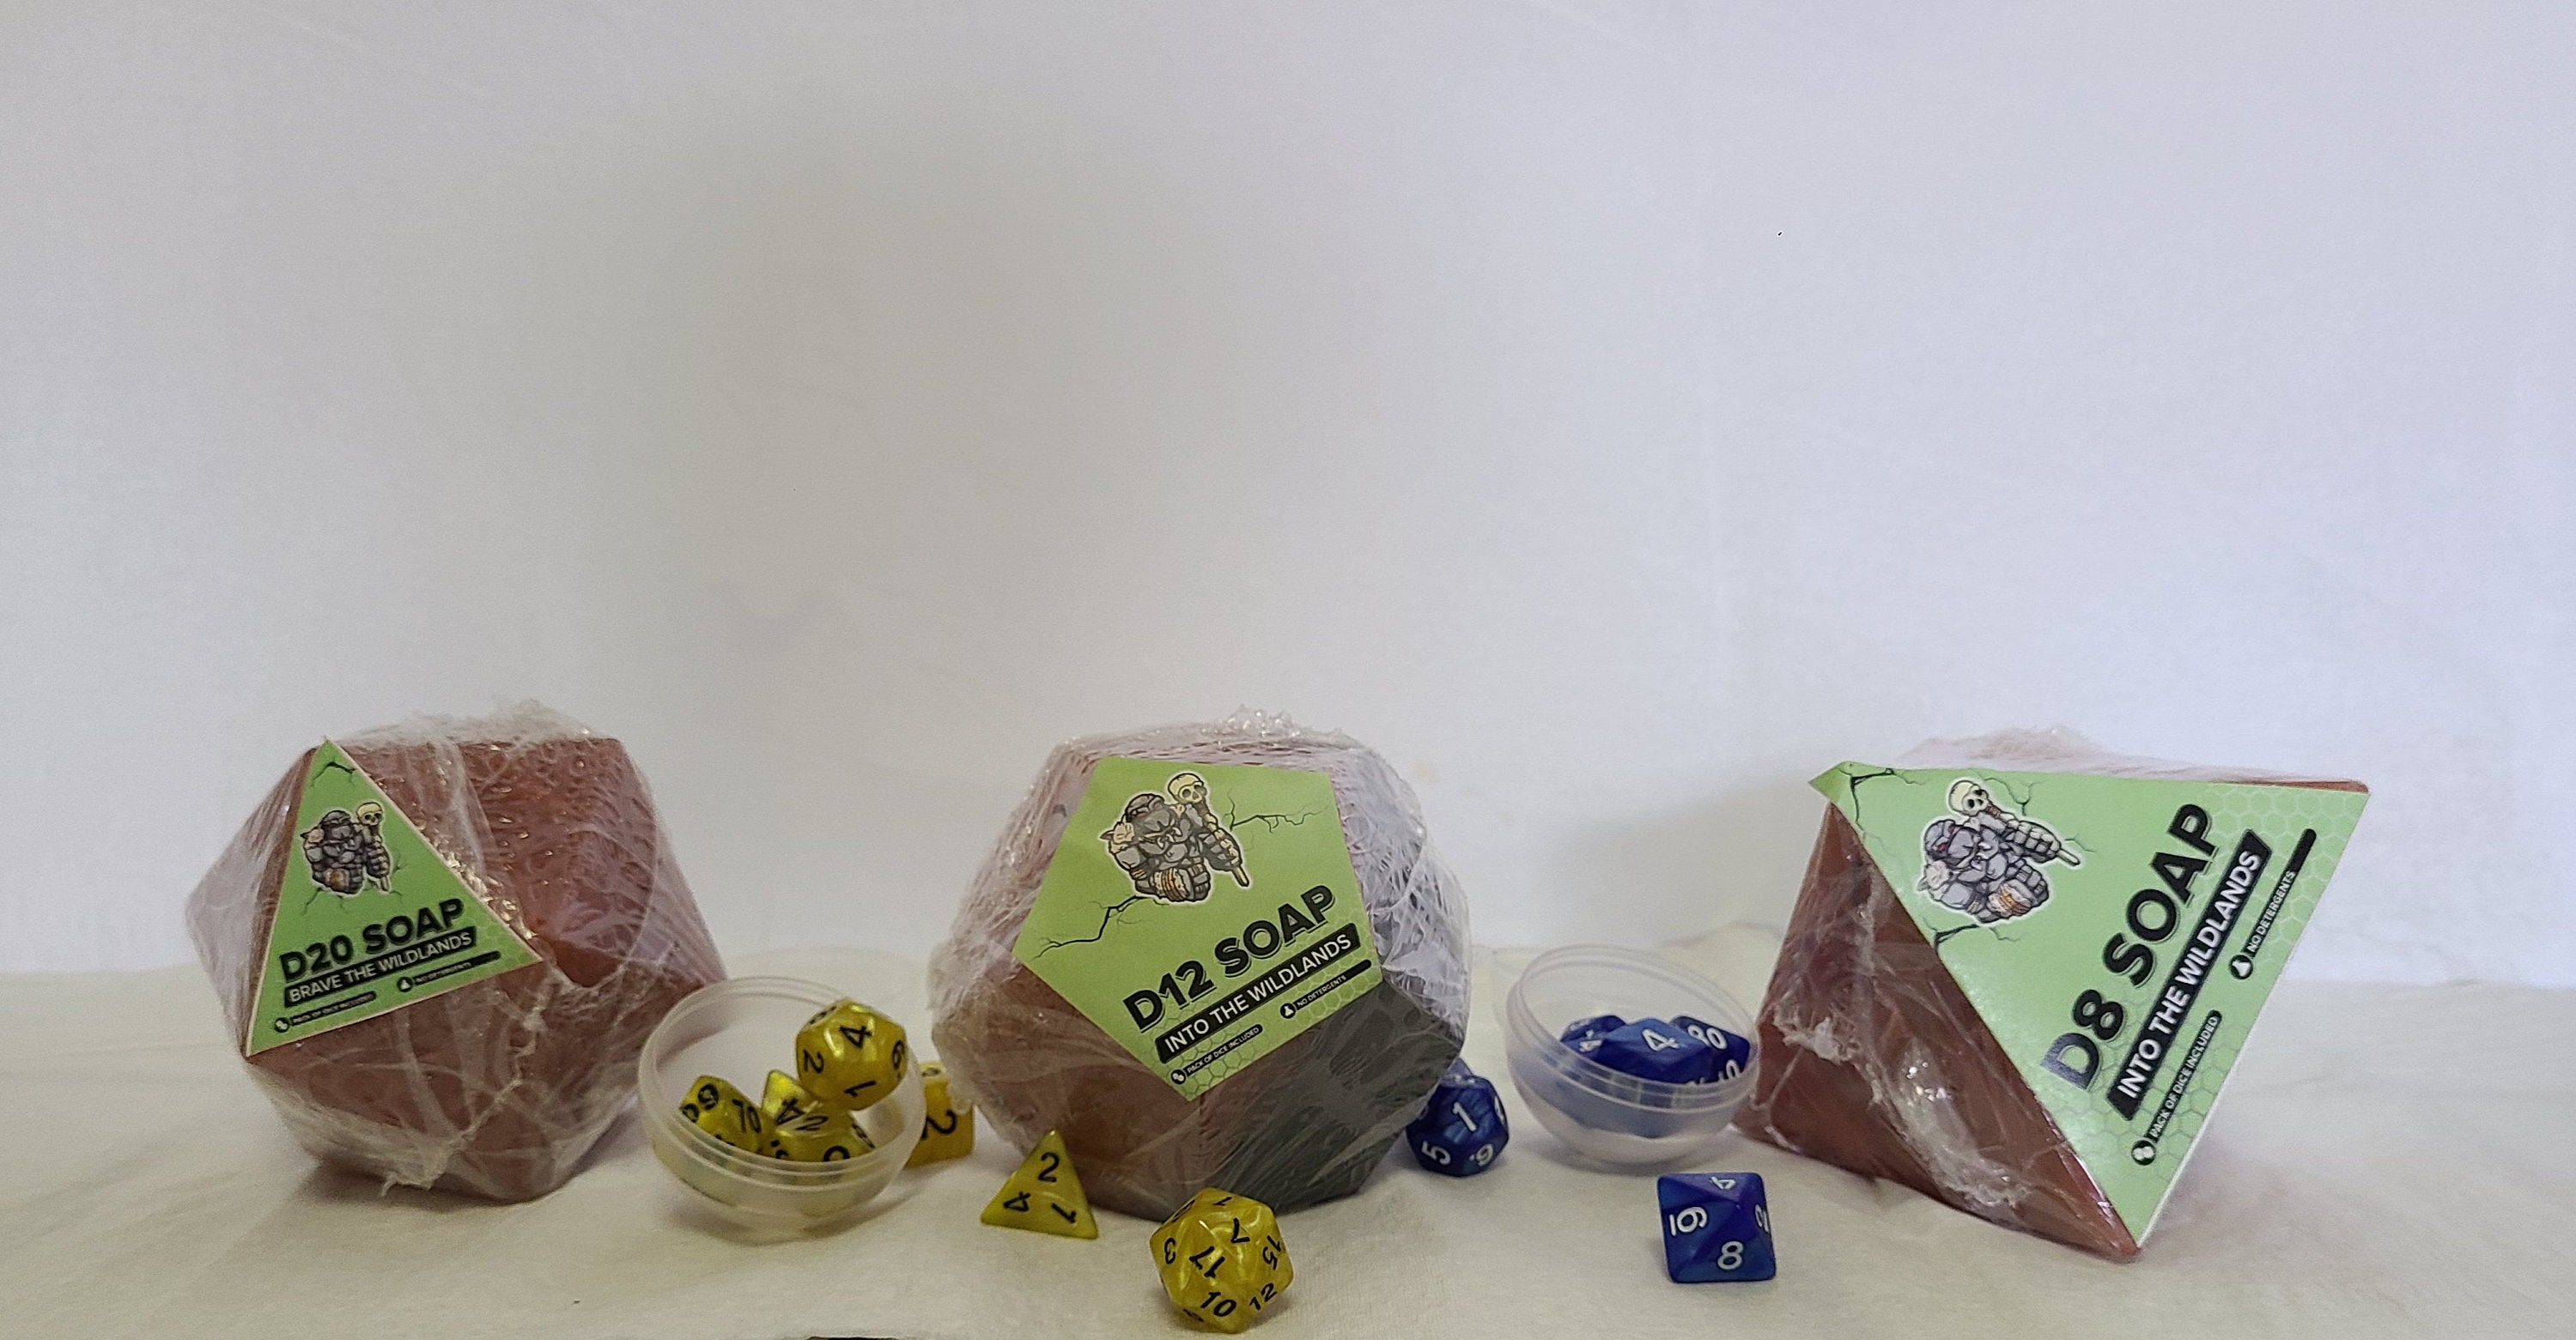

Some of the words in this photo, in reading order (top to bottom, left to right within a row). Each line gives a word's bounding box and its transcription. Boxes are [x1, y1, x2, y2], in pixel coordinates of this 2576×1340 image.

[2246, 934, 2262, 952] NO
[2256, 870, 2296, 936] DETERGENTS
[279, 935, 354, 983] D20
[361, 898, 465, 954] SOAP
[2041, 988, 2125, 1092] D8
[2103, 803, 2220, 988] SOAP
[289, 974, 343, 1003] BRAVE
[345, 963, 377, 985] THE
[378, 931, 472, 972] WILDLANDS
[1122, 960, 1218, 1034] D12
[1214, 884, 1335, 978] SOAP
[2117, 1038, 2162, 1099] INTO
[2148, 985, 2190, 1034] THE
[2175, 850, 2261, 985] WILDLANDS
[1163, 1019, 1210, 1053] INTO
[1209, 994, 1249, 1024] THE
[1247, 933, 1352, 1003] WILDLANDS
[1297, 997, 1308, 1007] NO
[1307, 974, 1346, 1002] DETERGENTS
[839, 1025, 872, 1049] 4
[1187, 1061, 1203, 1073] PACK
[1204, 1054, 1213, 1064] OF
[1213, 1046, 1228, 1058] DICE
[1228, 1027, 1260, 1049] INCLUDED
[1642, 1028, 1680, 1052] 4
[803, 1048, 824, 1073] 2
[843, 1080, 877, 1097] 1
[2149, 1109, 2170, 1137] PACK
[2165, 1093, 2178, 1110] OF
[2172, 1069, 2192, 1094] DICE
[2185, 1016, 2219, 1069] INCLUDED
[1452, 1101, 1477, 1131] 1
[1037, 1152, 1060, 1183] 2
[1421, 1140, 1451, 1166] 5
[1003, 1191, 1030, 1213] 4
[1051, 1203, 1077, 1224] 1
[1230, 1217, 1251, 1244] 7
[1163, 1237, 1176, 1264] 3
[1188, 1246, 1225, 1279] 17
[1262, 1234, 1281, 1270] 15
[1717, 1240, 1744, 1270] 8
[1200, 1291, 1237, 1317] 10
[1249, 1282, 1278, 1311] 12
